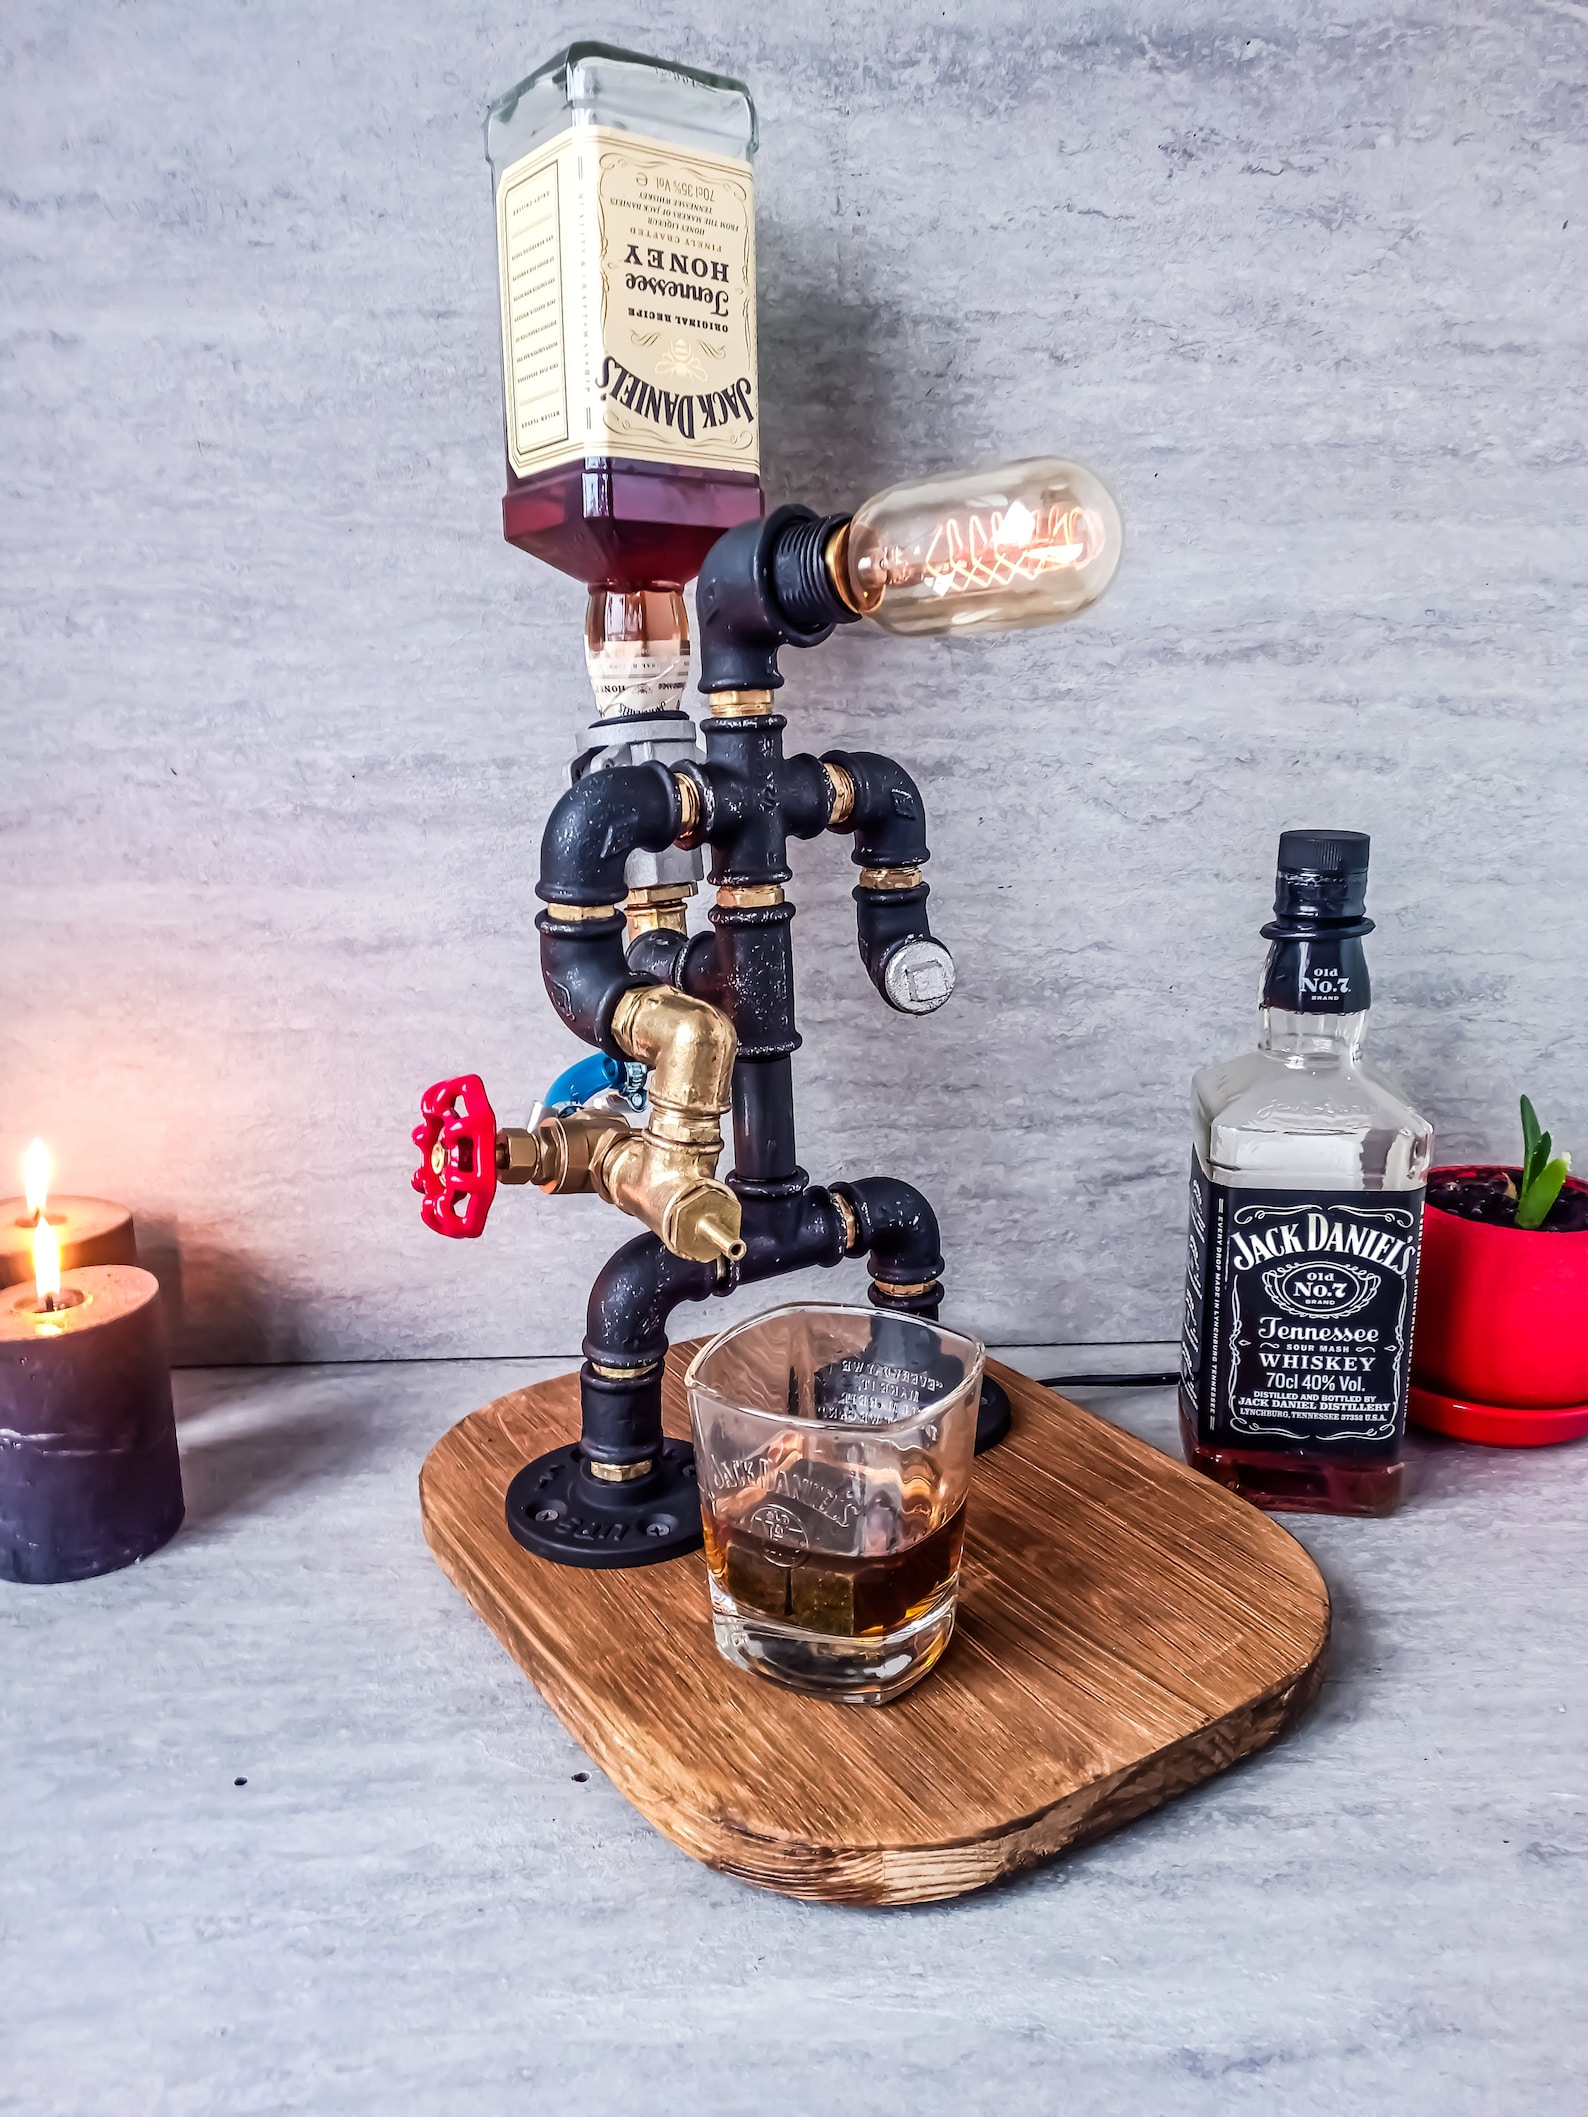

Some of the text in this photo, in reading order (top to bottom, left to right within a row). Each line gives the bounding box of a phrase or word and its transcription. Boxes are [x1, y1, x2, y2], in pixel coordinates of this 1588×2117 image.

[673, 180, 693, 197] 35%
[695, 186, 715, 202] 70cl
[638, 191, 713, 214] TENNESSEE WHISKEY
[647, 217, 705, 236] HONEY LIQUEUR
[629, 226, 722, 253] FINELY CRAFTED
[624, 244, 729, 283] HONEY
[625, 273, 729, 317] Tennessee
[628, 307, 728, 333] ORIGINAL RECIPE
[594, 356, 754, 440] JACK DANIEL'S
[1313, 967, 1338, 977] Old
[1216, 1216, 1224, 1246] EVERY
[1230, 1223, 1305, 1271] JACK
[1307, 1212, 1416, 1276] DANIEL'S
[1306, 1272, 1335, 1282] Old
[1292, 1281, 1348, 1298] No.7
[1214, 1299, 1220, 1309] IN
[1258, 1316, 1379, 1343] Tennessee
[1286, 1343, 1350, 1353] SOUR MASH
[1258, 1352, 1376, 1372] WHISKEY
[1266, 1372, 1366, 1392] 70cl 40% Vol.
[1238, 1396, 1392, 1412] JACK DANIEL DISTILLERY
[1253, 1390, 1377, 1403] DISTILLED AND BOTTLED BY
[1291, 1411, 1340, 1421] TENNESSEE
